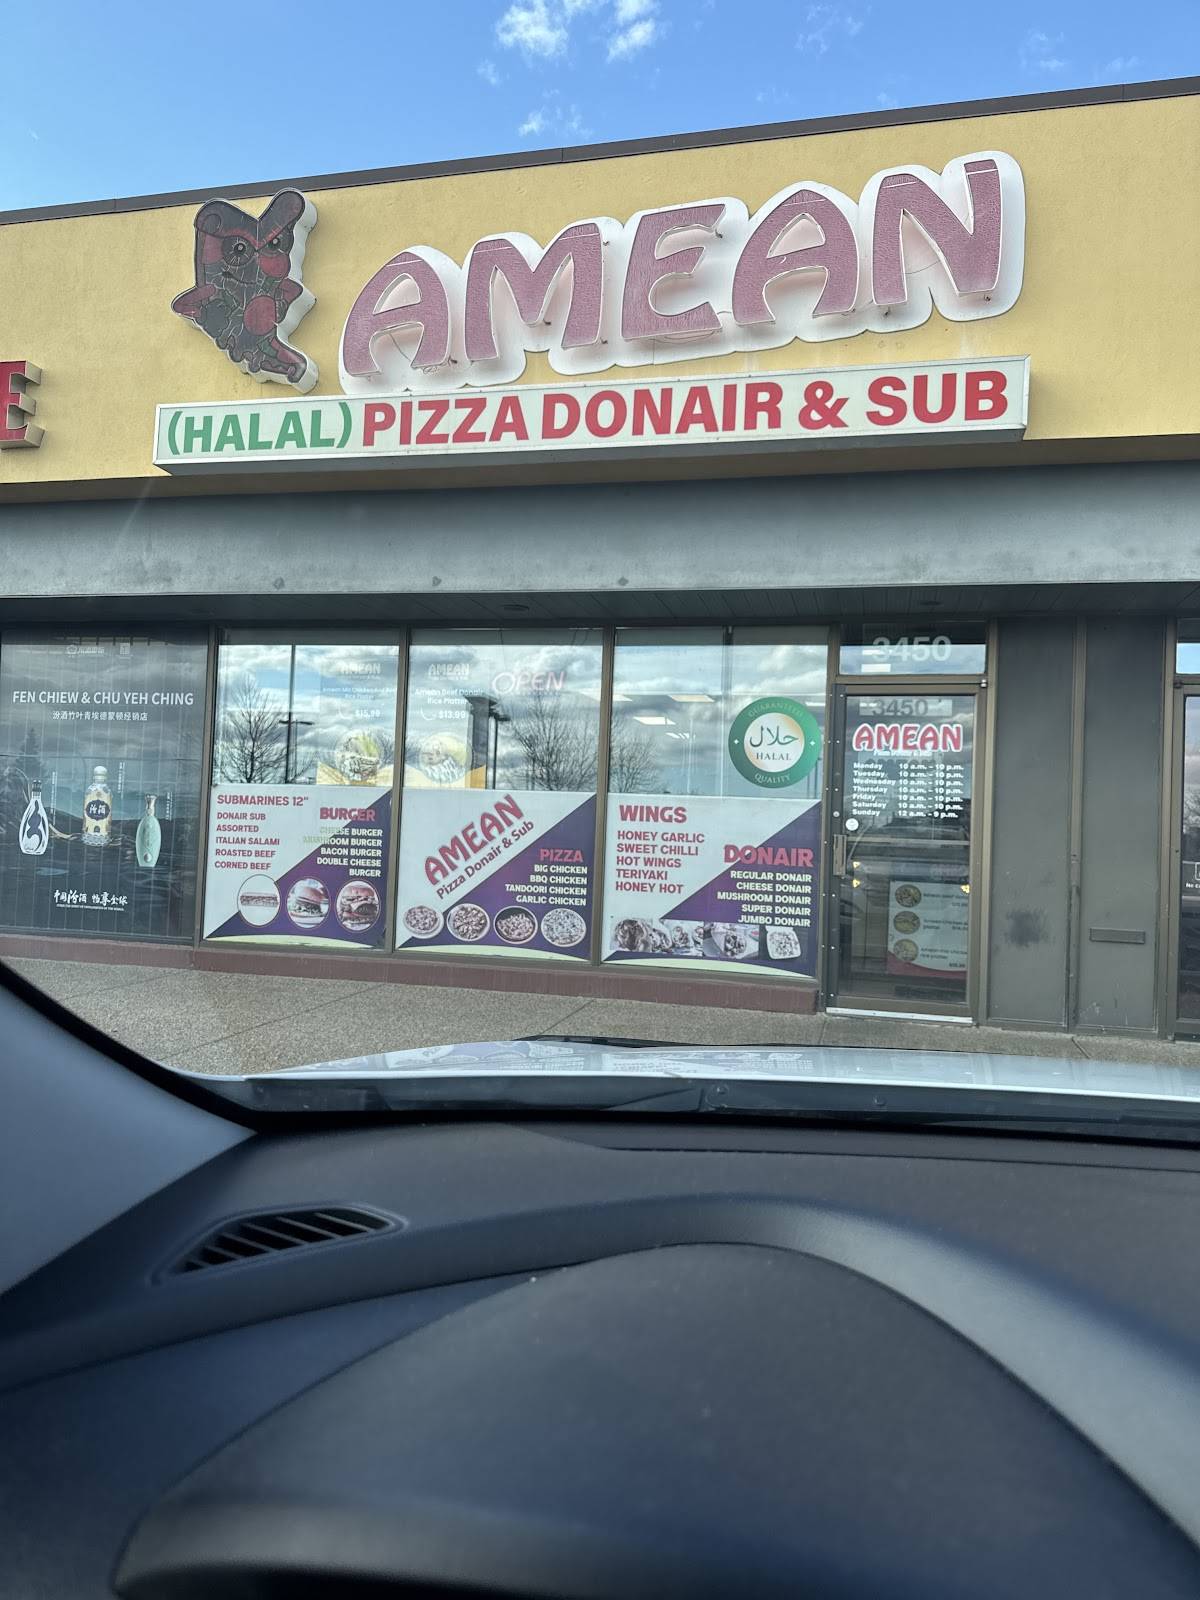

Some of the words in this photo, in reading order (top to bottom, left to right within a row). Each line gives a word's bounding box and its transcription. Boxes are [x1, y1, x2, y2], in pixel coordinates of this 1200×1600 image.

[340, 154, 1016, 384] AMEAN
[167, 401, 352, 455] (HALAL)
[362, 393, 529, 447] PIZZA
[541, 380, 783, 441] DONAIR
[798, 379, 849, 430] &
[866, 369, 1009, 426] SUB
[873, 635, 952, 662] 3450
[491, 671, 565, 695] OPEN
[12, 691, 36, 703] FEN
[39, 691, 79, 704] CHIEW
[81, 692, 91, 704] &
[93, 692, 121, 704] CHU
[123, 692, 148, 705] YEH
[151, 693, 194, 705] CHING
[872, 699, 929, 716] 3450
[749, 725, 799, 748] حلال
[853, 723, 963, 752] AMEAN
[756, 752, 792, 761] HALAL
[853, 762, 883, 770] Monday
[754, 773, 791, 784] QUALITY
[853, 770, 885, 778] Tuesday
[853, 786, 888, 794] Thursday
[217, 795, 289, 806] SUBMARINES
[292, 796, 309, 807] 12"
[852, 801, 887, 809] Saturday
[217, 812, 248, 820] DONAIR
[320, 807, 375, 821] BURGER
[619, 805, 688, 824] WINGS
[852, 809, 880, 817] Sunday
[216, 825, 259, 833] ASSORTED
[352, 828, 383, 837] BURGER
[216, 837, 246, 845] ITALIAN
[249, 837, 280, 845] SALAMI
[350, 838, 382, 847] BURGER
[424, 794, 524, 886] AMEAN
[617, 830, 658, 841] HONEY
[661, 832, 705, 843] GARLIC
[215, 849, 253, 857] ROASTED
[254, 850, 276, 858] BEEF
[321, 847, 348, 855] BACON
[350, 848, 382, 857] BURGER
[540, 848, 583, 863] PIZZA
[616, 844, 658, 854] SWEET
[660, 845, 699, 856] CHILLI
[724, 844, 814, 868] DONAIR
[215, 861, 248, 869] CORNED
[250, 862, 272, 870] BEEF
[317, 857, 348, 866] DOUBLE
[350, 858, 381, 867] CHEESE
[436, 875, 466, 900] Pizza
[464, 845, 502, 879] Donair
[501, 837, 512, 849] &
[511, 820, 535, 842] Sub
[616, 856, 640, 866] HOT
[643, 857, 682, 868] WINGS
[349, 868, 381, 877] BURGER
[534, 864, 548, 872] BIG
[550, 865, 587, 874] CHICKEN
[616, 869, 668, 880] TERIYAKI
[530, 875, 548, 884] BBQ
[549, 876, 587, 885] CHICKEN
[730, 870, 774, 881] REGULAR
[775, 872, 812, 883] DONAIR
[505, 884, 547, 894] TANDOORI
[549, 886, 587, 895] CHICKEN
[615, 881, 655, 892] HONEY
[659, 883, 684, 894] HOT
[736, 882, 773, 892] CHEESE
[775, 883, 812, 894] DONAIR
[516, 895, 547, 904] GARLIC
[548, 896, 587, 906] CHICKEN
[717, 891, 773, 903] MUSHROOM
[774, 894, 811, 904] DONAIR
[741, 904, 773, 914] SUPER
[774, 906, 811, 916] DONAIR
[737, 915, 772, 925] JUMBO
[774, 916, 811, 927] DONAIR
